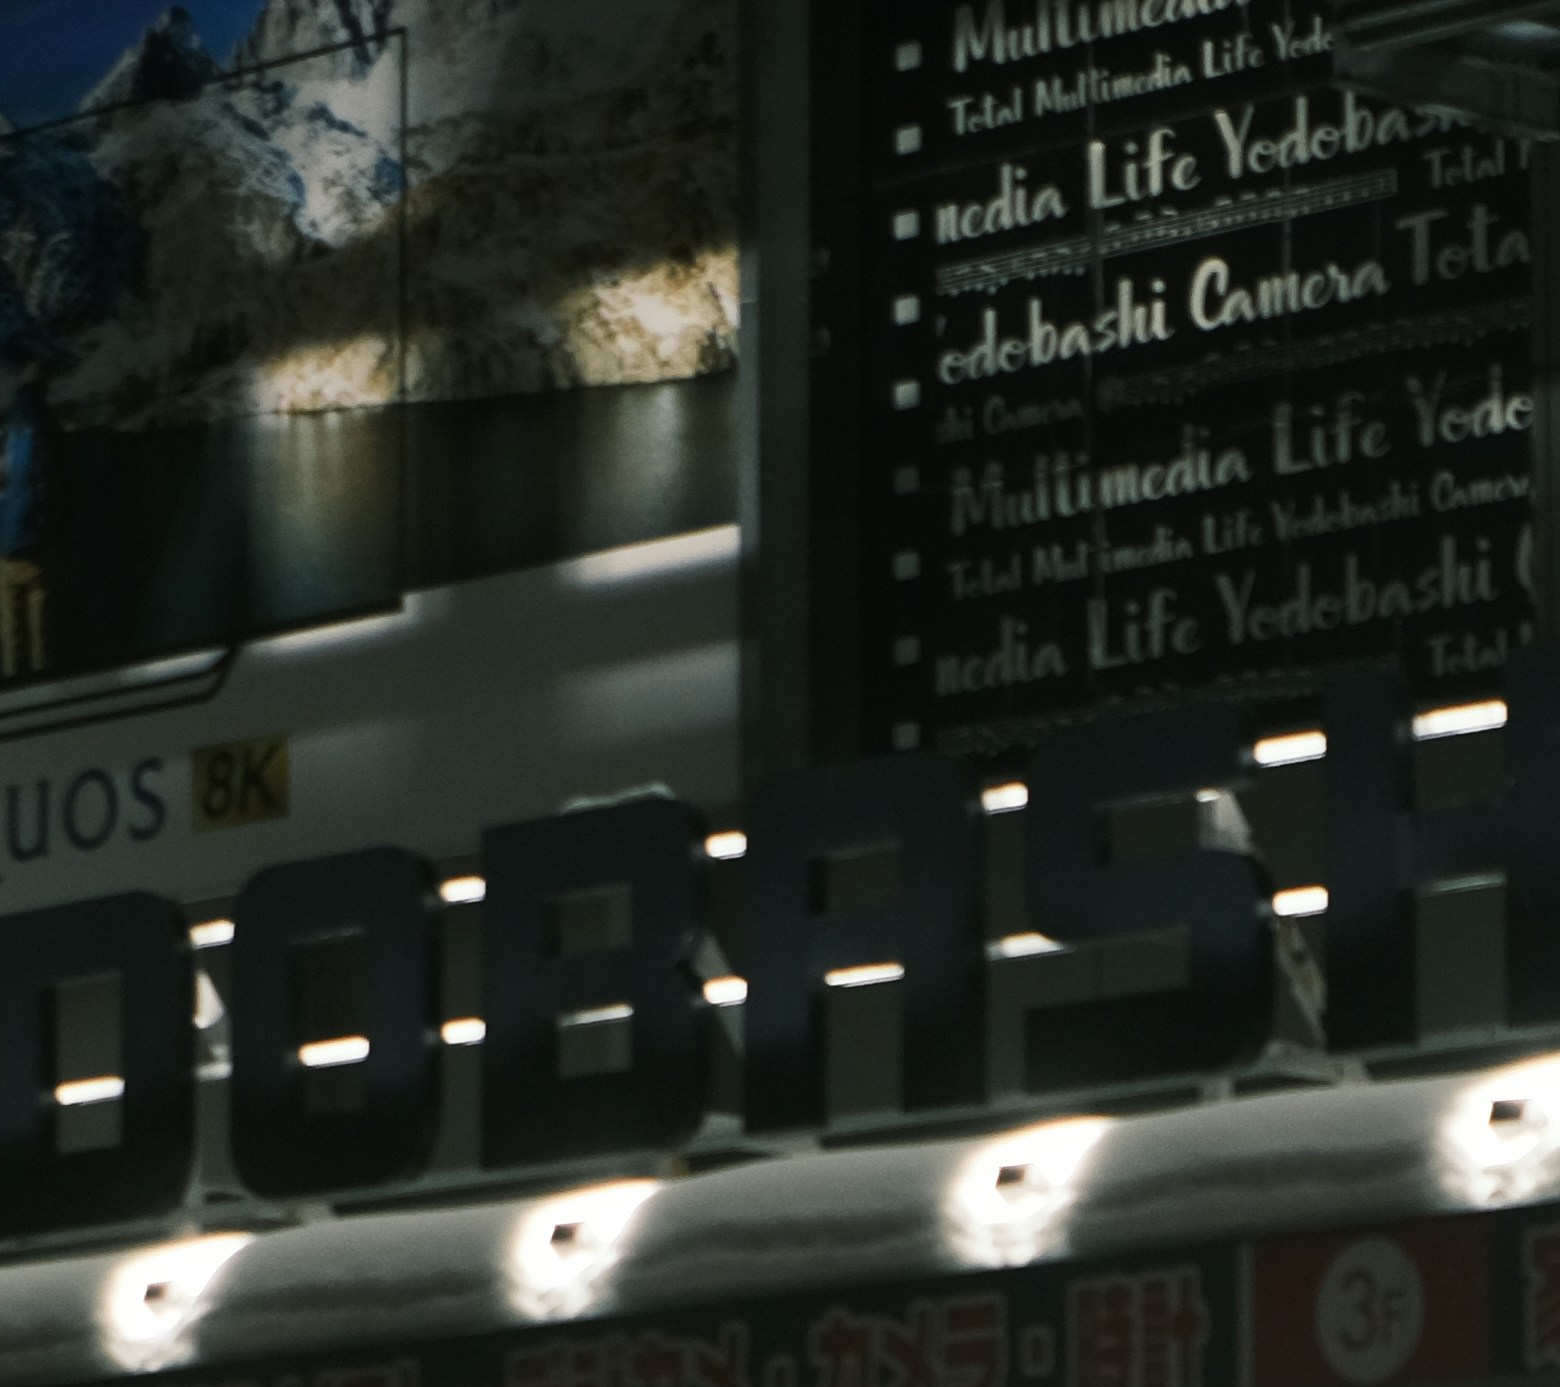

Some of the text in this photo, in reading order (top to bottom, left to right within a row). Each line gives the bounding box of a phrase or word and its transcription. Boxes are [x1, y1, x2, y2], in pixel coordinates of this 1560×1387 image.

[947, 85, 1022, 136] Total
[1037, 50, 1192, 116] Multimedia
[1202, 30, 1266, 80] Life
[1087, 128, 1202, 208] Life
[1190, 257, 1392, 330] Camera
[950, 422, 1253, 536] Multimedia
[1272, 392, 1393, 475] Life
[1201, 507, 1264, 555] Life
[1087, 587, 1203, 671] Life
[1215, 535, 1500, 645] Yodobashi
[198, 742, 288, 816] 8K
[1340, 1268, 1403, 1353] 3F
